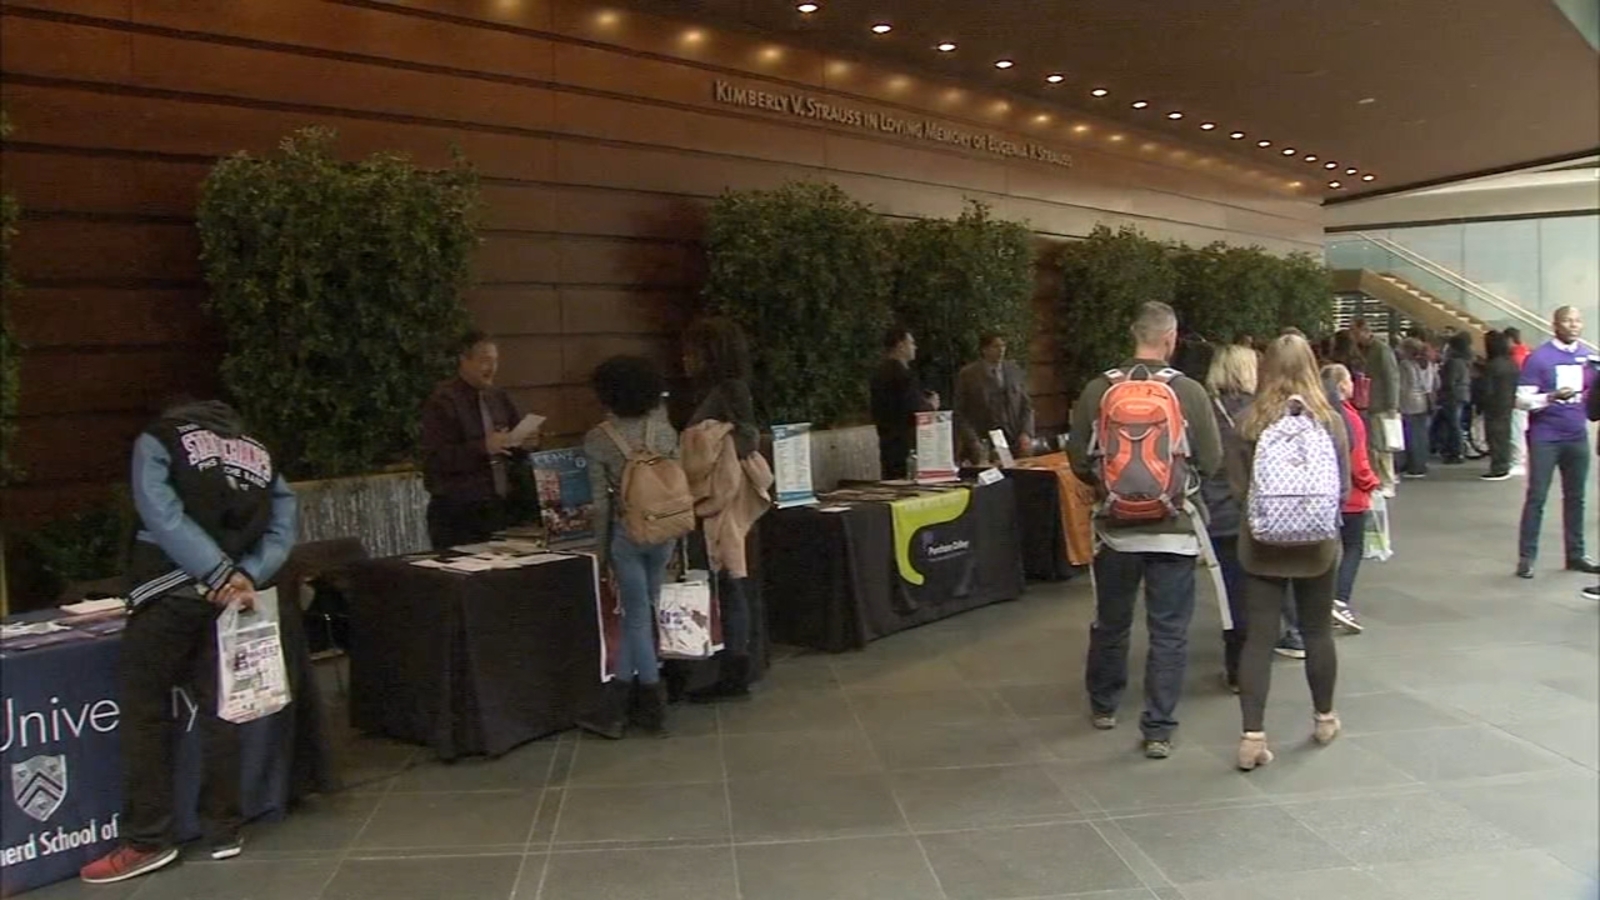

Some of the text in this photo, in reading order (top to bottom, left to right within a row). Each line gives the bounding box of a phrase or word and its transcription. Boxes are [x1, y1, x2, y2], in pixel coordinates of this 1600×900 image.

[715, 80, 789, 111] KIMBERLY
[791, 94, 805, 116] V.
[807, 98, 861, 126] STRAUSS
[864, 114, 878, 128] IN
[880, 112, 923, 138] LOVING
[924, 120, 972, 148] MEMORY
[40, 819, 97, 856] School
[101, 813, 119, 840] of
